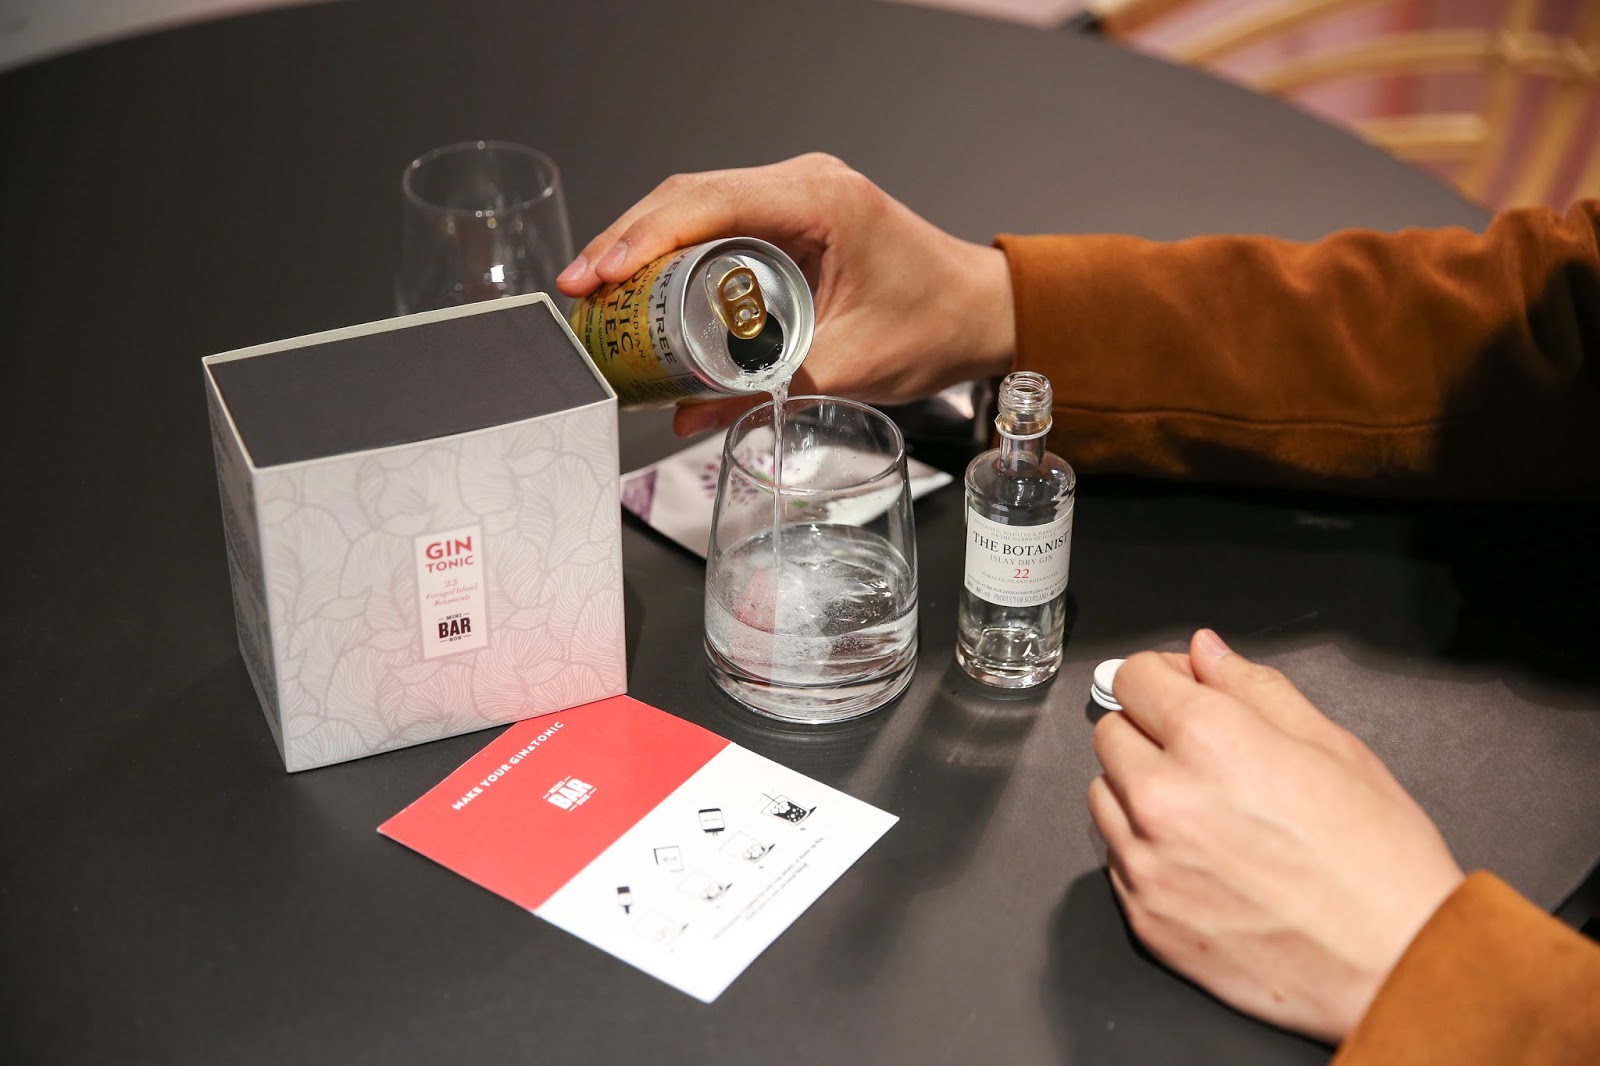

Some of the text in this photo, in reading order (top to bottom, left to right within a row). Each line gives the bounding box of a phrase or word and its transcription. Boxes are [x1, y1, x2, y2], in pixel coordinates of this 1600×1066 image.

[619, 263, 650, 353] ONIC
[605, 294, 621, 360] TER
[632, 303, 646, 358] INDIAN
[425, 535, 473, 560] GIN
[972, 529, 1071, 556] THE BOTANIST
[426, 555, 474, 573] TONIC
[990, 554, 1017, 566] ISLAY
[1039, 554, 1054, 564] GIN
[1013, 568, 1030, 579] 22
[438, 616, 472, 640] BAR
[451, 786, 484, 811] MAKE
[480, 763, 512, 788] YOUR
[547, 778, 593, 810] BAR
